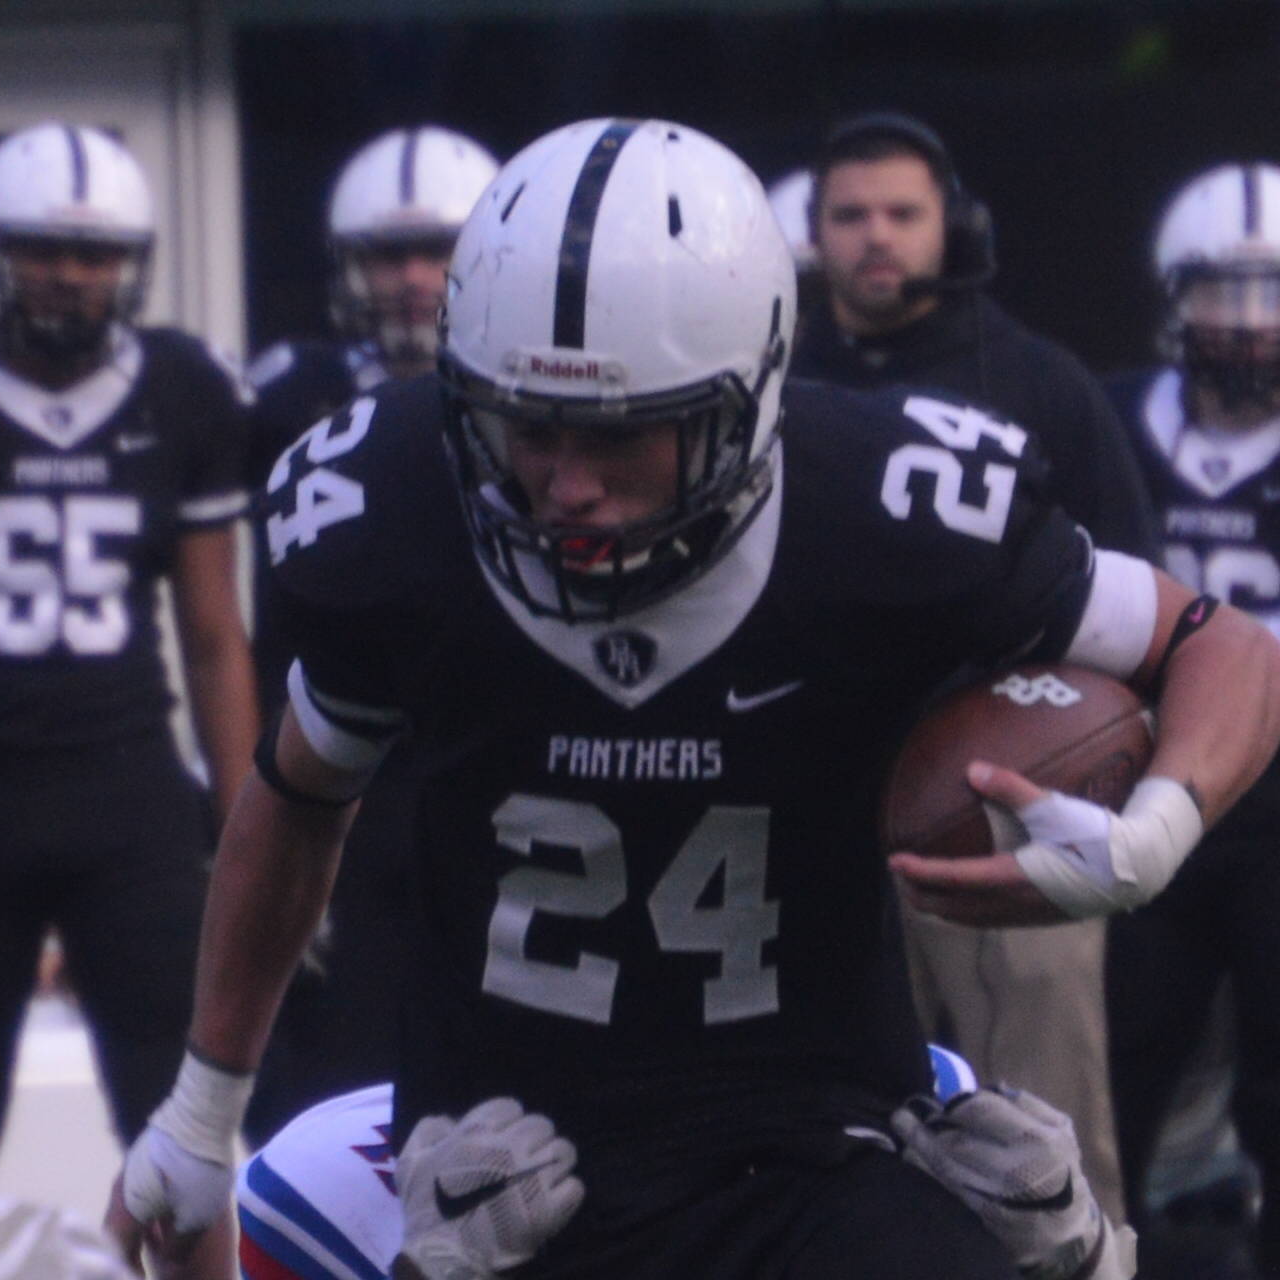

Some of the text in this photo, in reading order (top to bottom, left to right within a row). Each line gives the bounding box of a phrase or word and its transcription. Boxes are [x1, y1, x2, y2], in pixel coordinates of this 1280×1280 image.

[531, 356, 599, 380] Riddell
[266, 397, 378, 568] 24
[880, 396, 1028, 545] 24
[547, 735, 723, 781] PANTHERS
[481, 792, 782, 1026] 24
